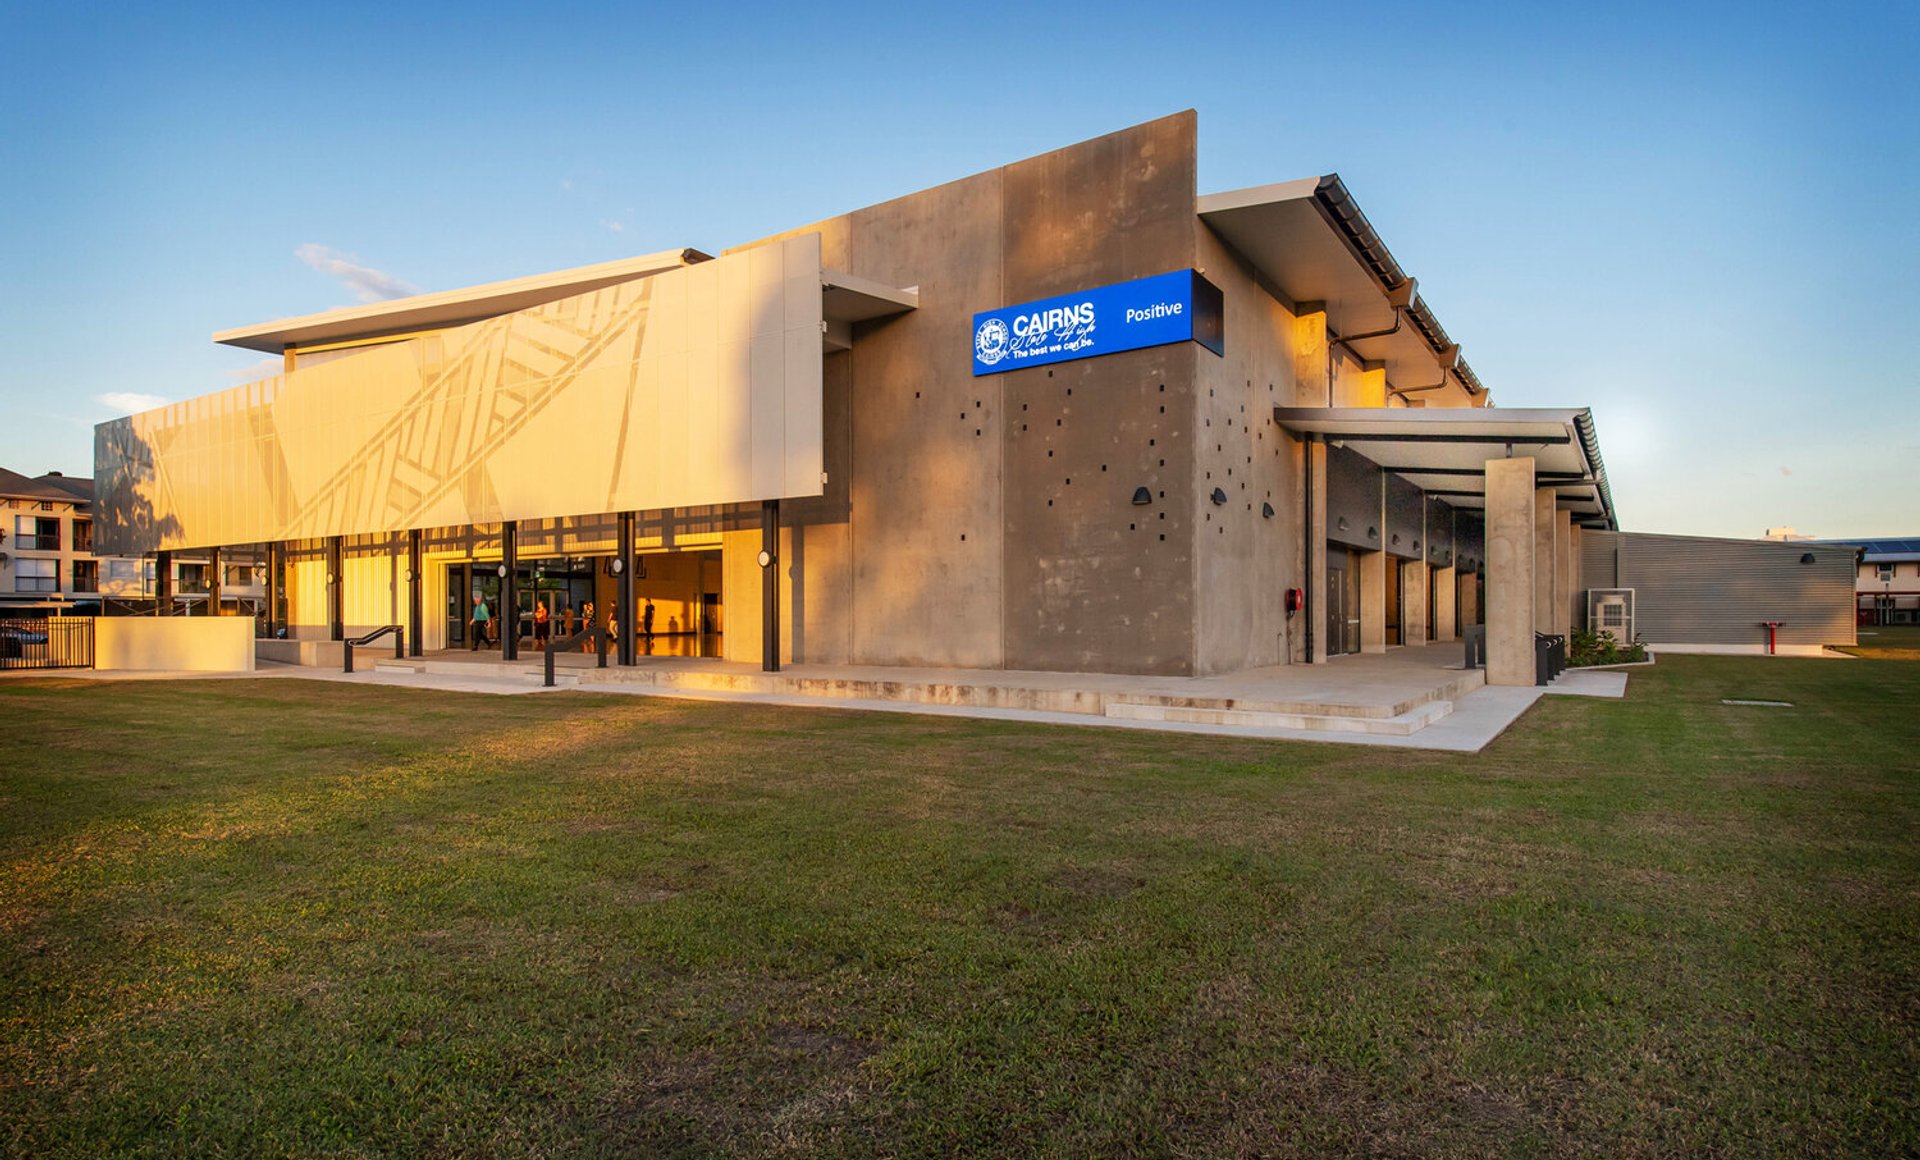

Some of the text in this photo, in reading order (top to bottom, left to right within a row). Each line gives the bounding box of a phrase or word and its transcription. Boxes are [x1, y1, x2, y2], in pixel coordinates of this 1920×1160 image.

[1013, 302, 1094, 336] CAIRNS
[1126, 301, 1183, 323] Positive
[1007, 330, 1048, 356] State
[1054, 319, 1096, 350] High
[1013, 338, 1095, 359] The best we can be.
